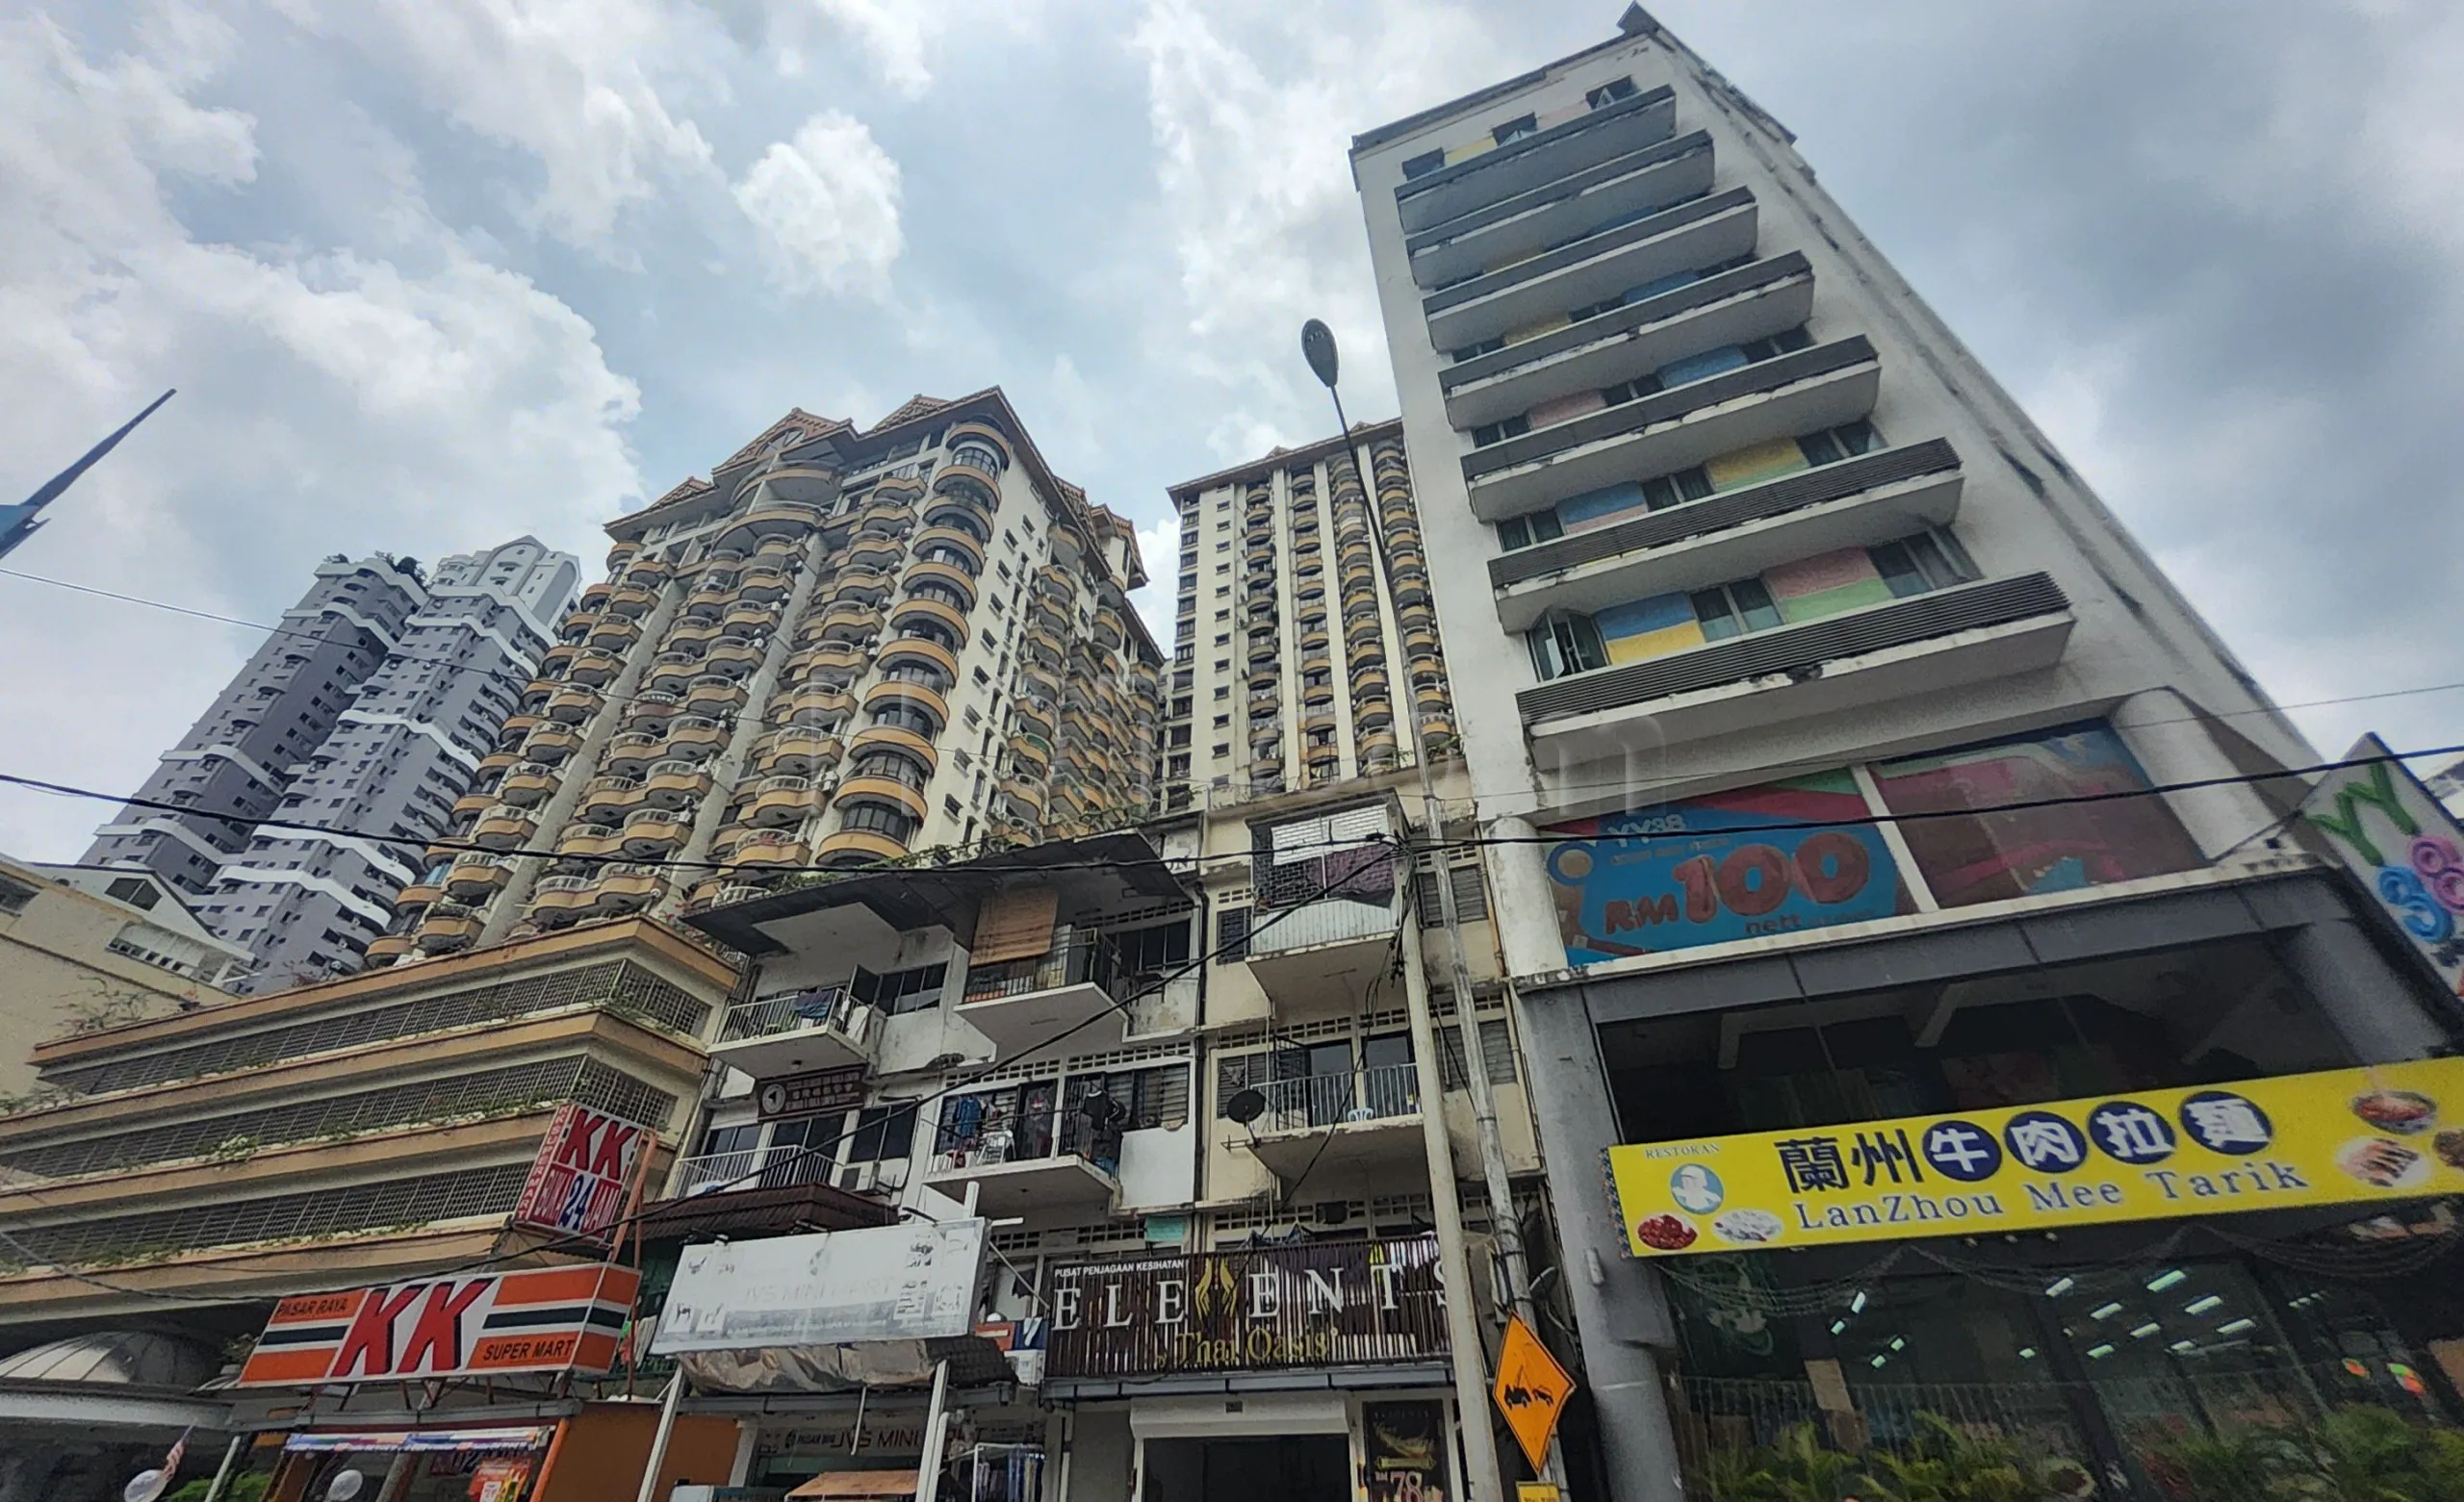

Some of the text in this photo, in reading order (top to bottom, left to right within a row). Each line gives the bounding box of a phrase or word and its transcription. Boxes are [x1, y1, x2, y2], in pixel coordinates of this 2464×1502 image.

[1745, 913, 1801, 934] nett
[558, 1108, 639, 1182] KK
[1645, 1142, 1720, 1159] RESTORAN
[558, 1173, 597, 1230] 24
[1794, 1161, 2309, 1231] LanZhou Mee Tarik
[1054, 1259, 1185, 1278] PUSAT PENJAGAAN KESIHATAN
[277, 1297, 348, 1317] PASAR RAYA
[329, 1276, 498, 1378] KK
[483, 1339, 578, 1361] SUPER MART
[1176, 1331, 1238, 1364] Thai
[1246, 1324, 1327, 1360] Oasis
